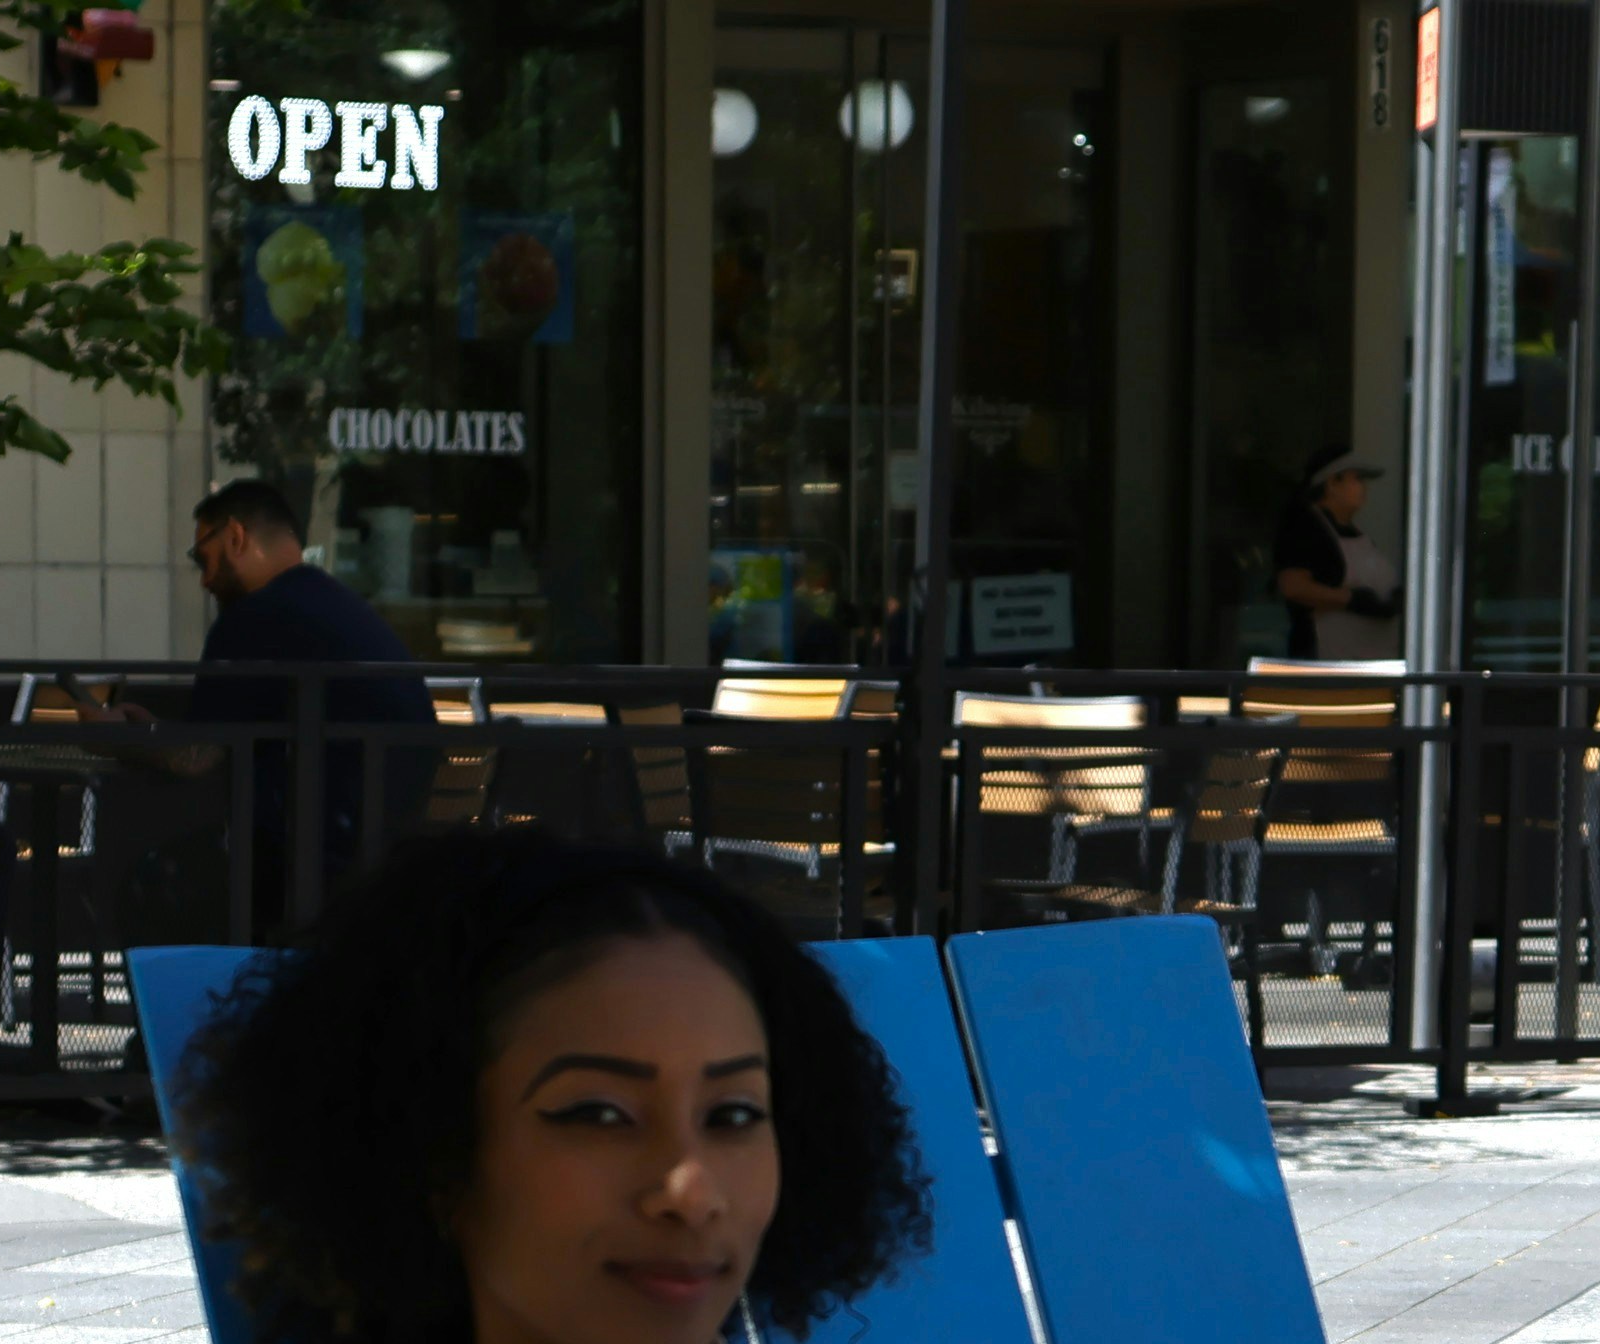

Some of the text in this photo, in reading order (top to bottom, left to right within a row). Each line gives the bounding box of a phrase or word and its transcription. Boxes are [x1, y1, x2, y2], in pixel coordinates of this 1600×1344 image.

[227, 94, 445, 191] OPEN
[328, 406, 527, 454] CHOCOLATES
[1512, 433, 1553, 472] ICE
